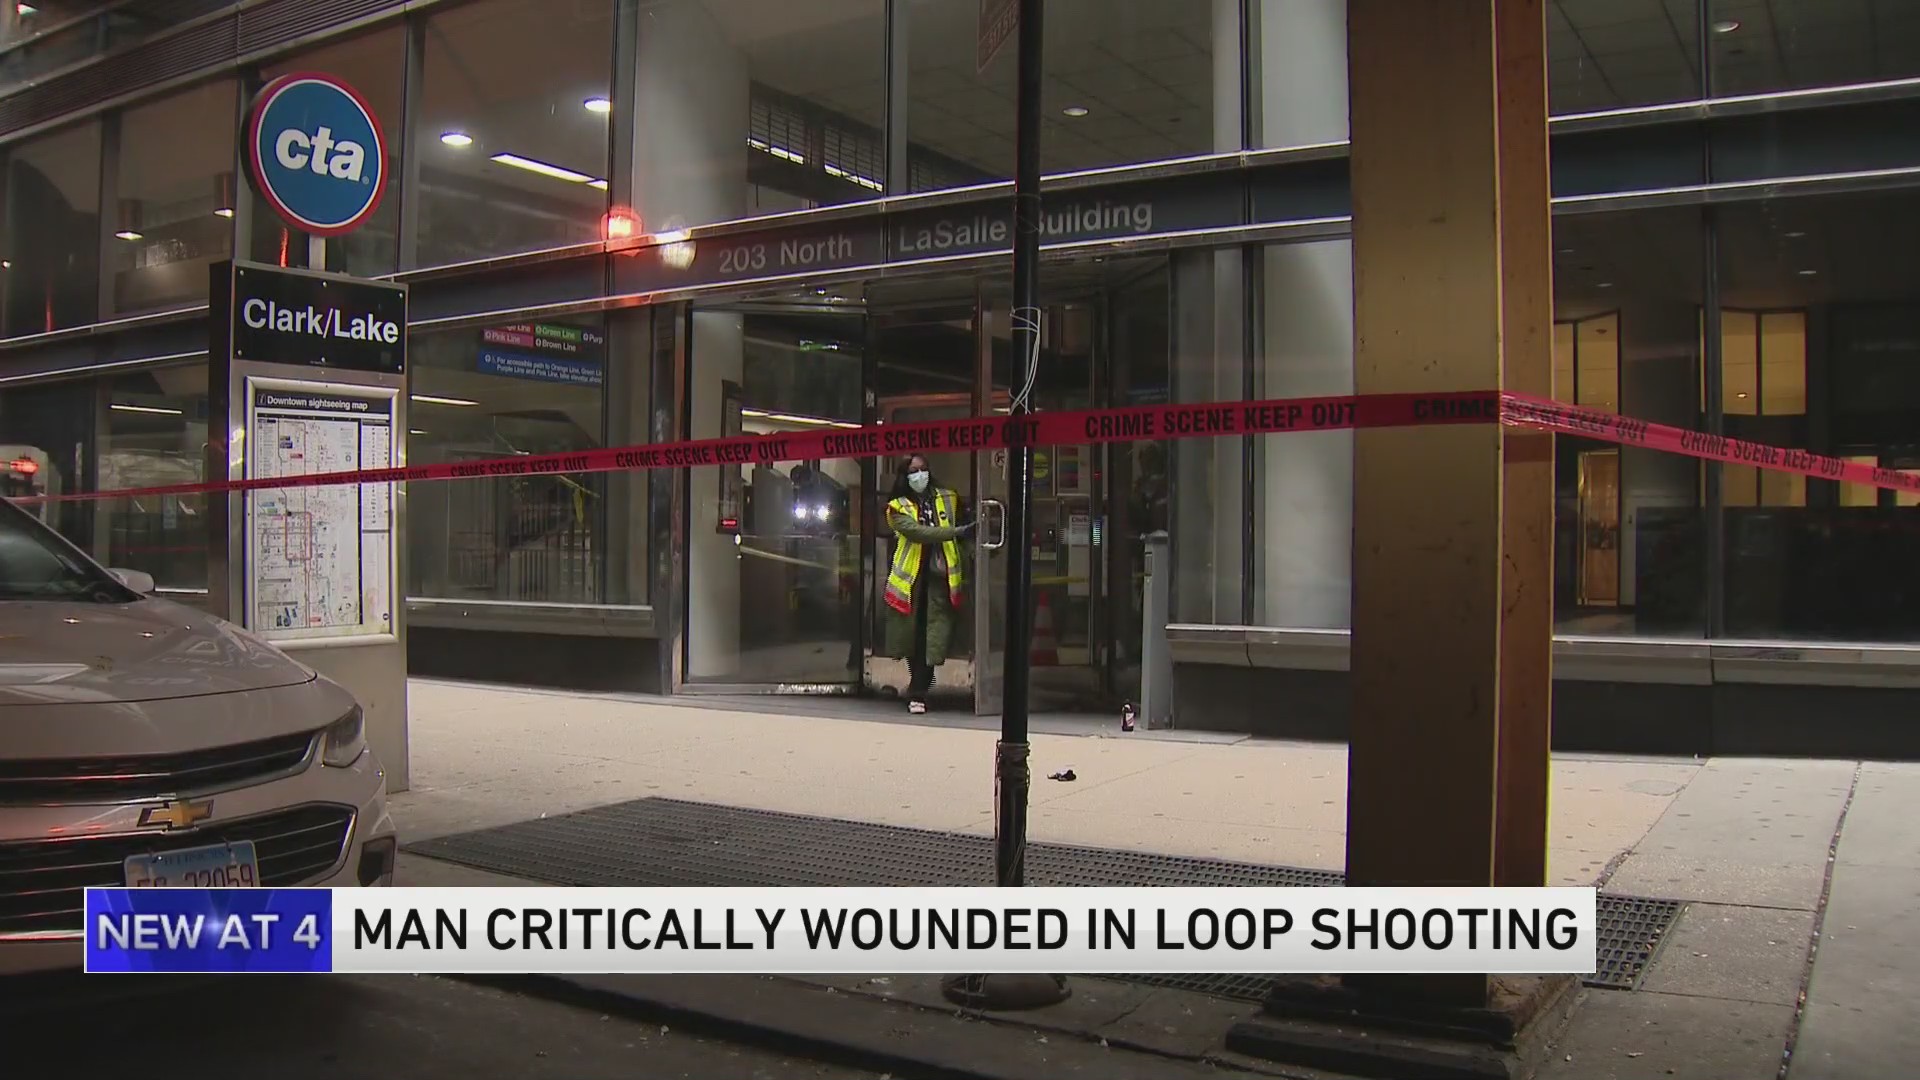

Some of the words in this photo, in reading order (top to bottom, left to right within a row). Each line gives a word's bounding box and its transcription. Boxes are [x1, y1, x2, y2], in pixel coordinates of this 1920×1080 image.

[275, 126, 365, 182] cta
[720, 246, 766, 274] 203
[780, 235, 853, 265] North
[899, 216, 1006, 252] LaSalle
[243, 298, 399, 343] Clark/Lake
[492, 332, 506, 342] Pink
[507, 334, 521, 344] Line
[543, 326, 561, 338] Green
[562, 328, 575, 339] Line
[543, 339, 562, 350] Brown
[563, 342, 577, 352] Line
[267, 395, 307, 407] Downtown
[309, 397, 351, 410] sightseeing
[352, 402, 368, 411] map
[1085, 413, 1154, 438] CRIME
[1163, 408, 1234, 433] SCENE
[1244, 404, 1303, 429] KEEP
[1312, 402, 1358, 426] OUT
[1413, 399, 1496, 418] CRIME
[1615, 415, 1648, 440] OUT
[616, 450, 661, 469] CRIME
[666, 447, 710, 466] SCENE
[716, 443, 753, 462] KEEP
[759, 440, 789, 460] OUT
[823, 432, 878, 455] CRIME
[885, 428, 940, 450] SCENE
[948, 424, 994, 448] KEEP
[1002, 420, 1040, 443] OUT
[1681, 430, 1729, 456] CRIME
[1734, 440, 1777, 464] SCENE
[1783, 449, 1816, 470] KEEP
[1821, 456, 1845, 476] OUT
[451, 464, 485, 477] CRIME
[489, 461, 525, 474] SCENE
[530, 458, 559, 472] KEEP
[564, 455, 590, 470] OUT
